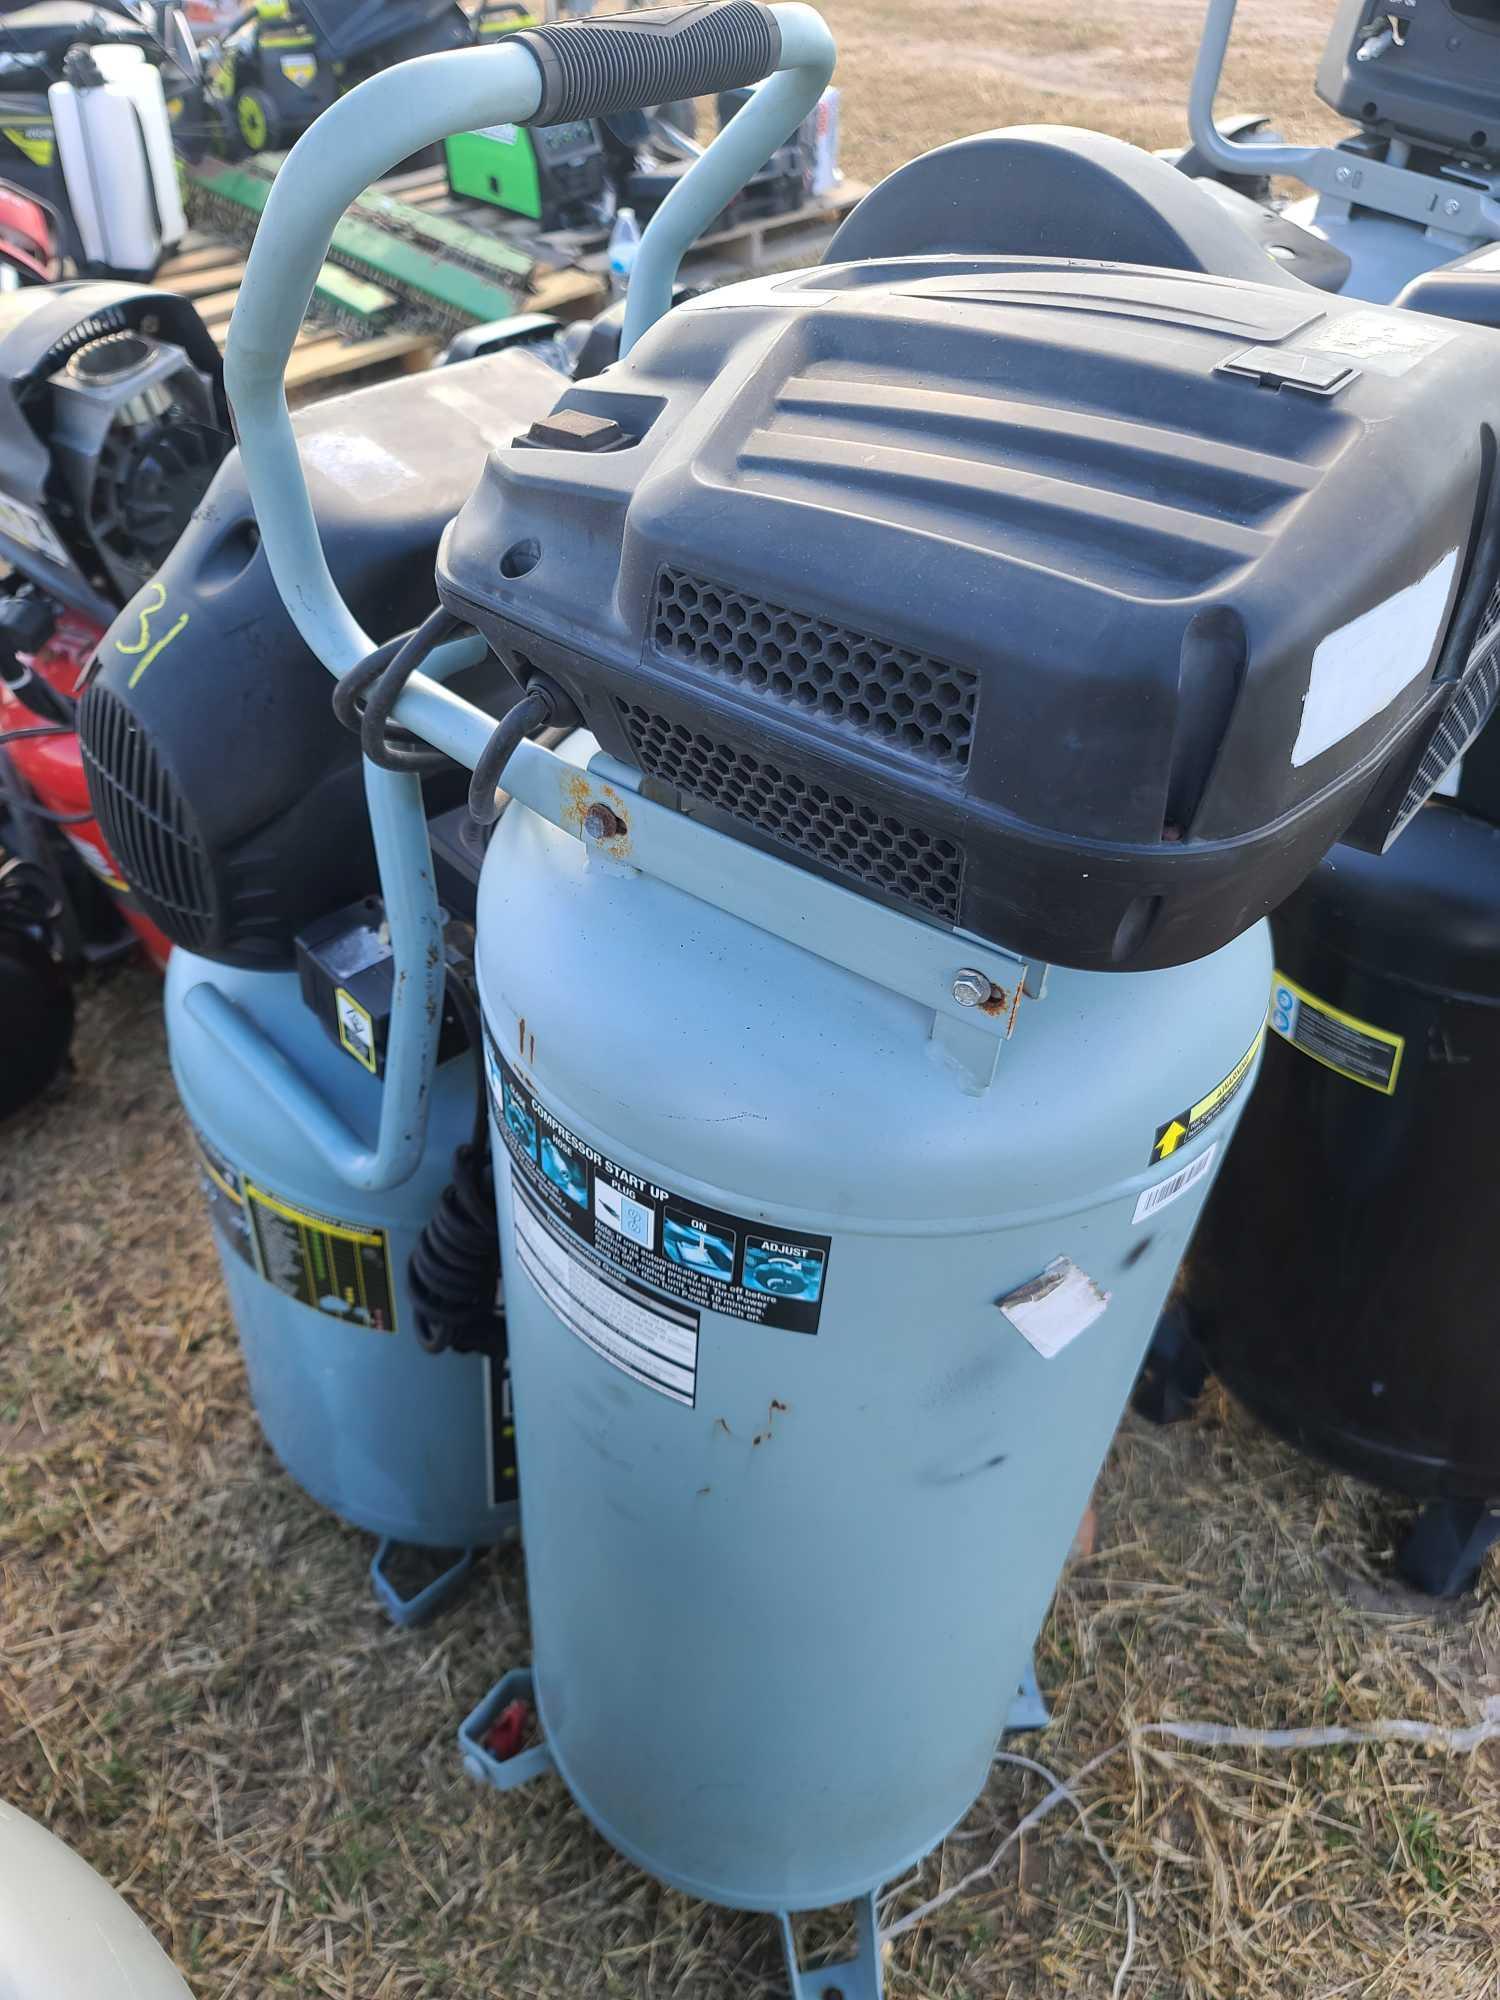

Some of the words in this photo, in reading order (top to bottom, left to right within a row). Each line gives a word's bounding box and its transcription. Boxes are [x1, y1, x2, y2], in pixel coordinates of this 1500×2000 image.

[531, 1098, 602, 1167] COMPRESSOR
[604, 1160, 647, 1192] START
[649, 1185, 670, 1201] UP
[551, 1133, 573, 1158] HOSE
[611, 1179, 637, 1201] PLUG
[691, 1219, 707, 1232] ON
[760, 1240, 809, 1258] ADJUST
[640, 1249, 699, 1281] automatically
[730, 1285, 743, 1295] off
[745, 1289, 777, 1304] before
[714, 1286, 734, 1300] Turn
[736, 1293, 768, 1309] Power
